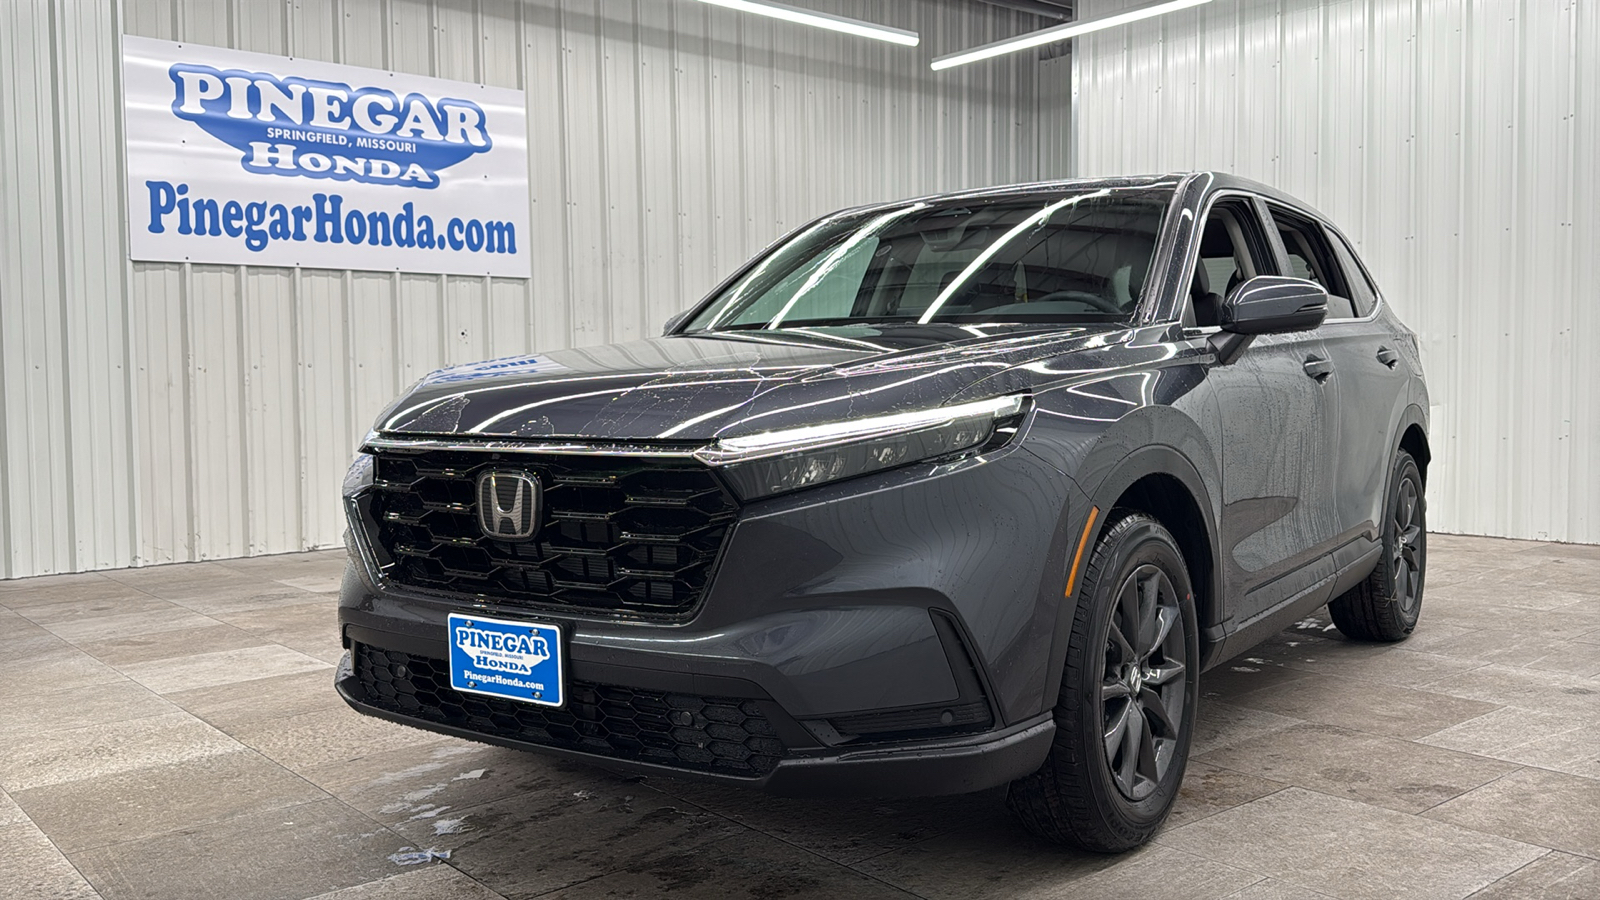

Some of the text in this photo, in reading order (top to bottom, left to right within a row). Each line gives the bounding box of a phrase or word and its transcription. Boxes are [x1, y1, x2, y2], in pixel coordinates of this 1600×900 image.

[177, 71, 486, 147] PINEGAR
[267, 127, 417, 154] SPRINGFIELD, MISSOURI
[248, 142, 434, 183] HONDA
[146, 180, 517, 254] PinegarHonda.com
[458, 630, 548, 657] PINEGAR
[475, 655, 529, 672] HONDA
[463, 670, 545, 691] PinegarHonda.com
